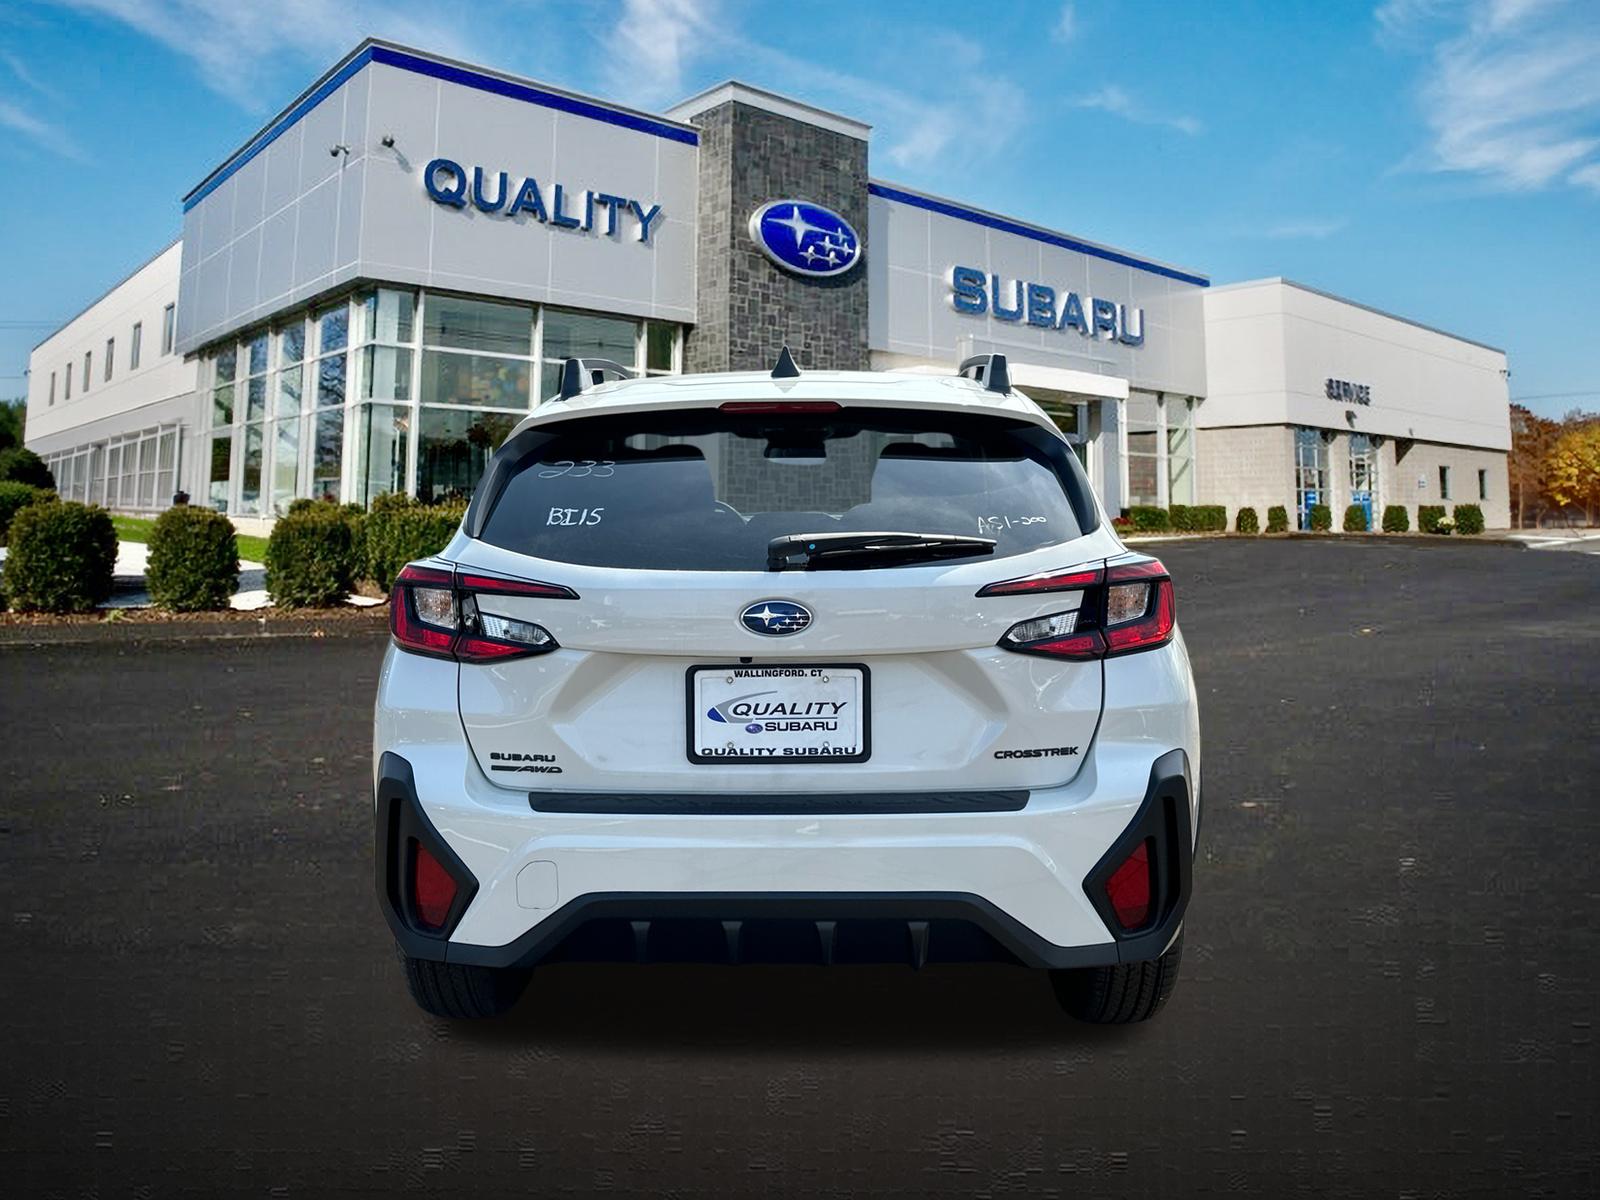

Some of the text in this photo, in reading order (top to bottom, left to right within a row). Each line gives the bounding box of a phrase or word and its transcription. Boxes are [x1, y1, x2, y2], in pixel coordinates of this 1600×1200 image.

[424, 158, 662, 242] QUALITY
[951, 265, 1145, 346] SUBARU
[538, 460, 615, 478] 233
[810, 669, 823, 677] CT
[732, 701, 848, 716] QUALITY
[764, 721, 838, 732] SUBARU
[490, 752, 556, 762] SUBARU
[701, 746, 857, 756] QUALITY SUBARU
[994, 746, 1079, 759] CROSSTREK
